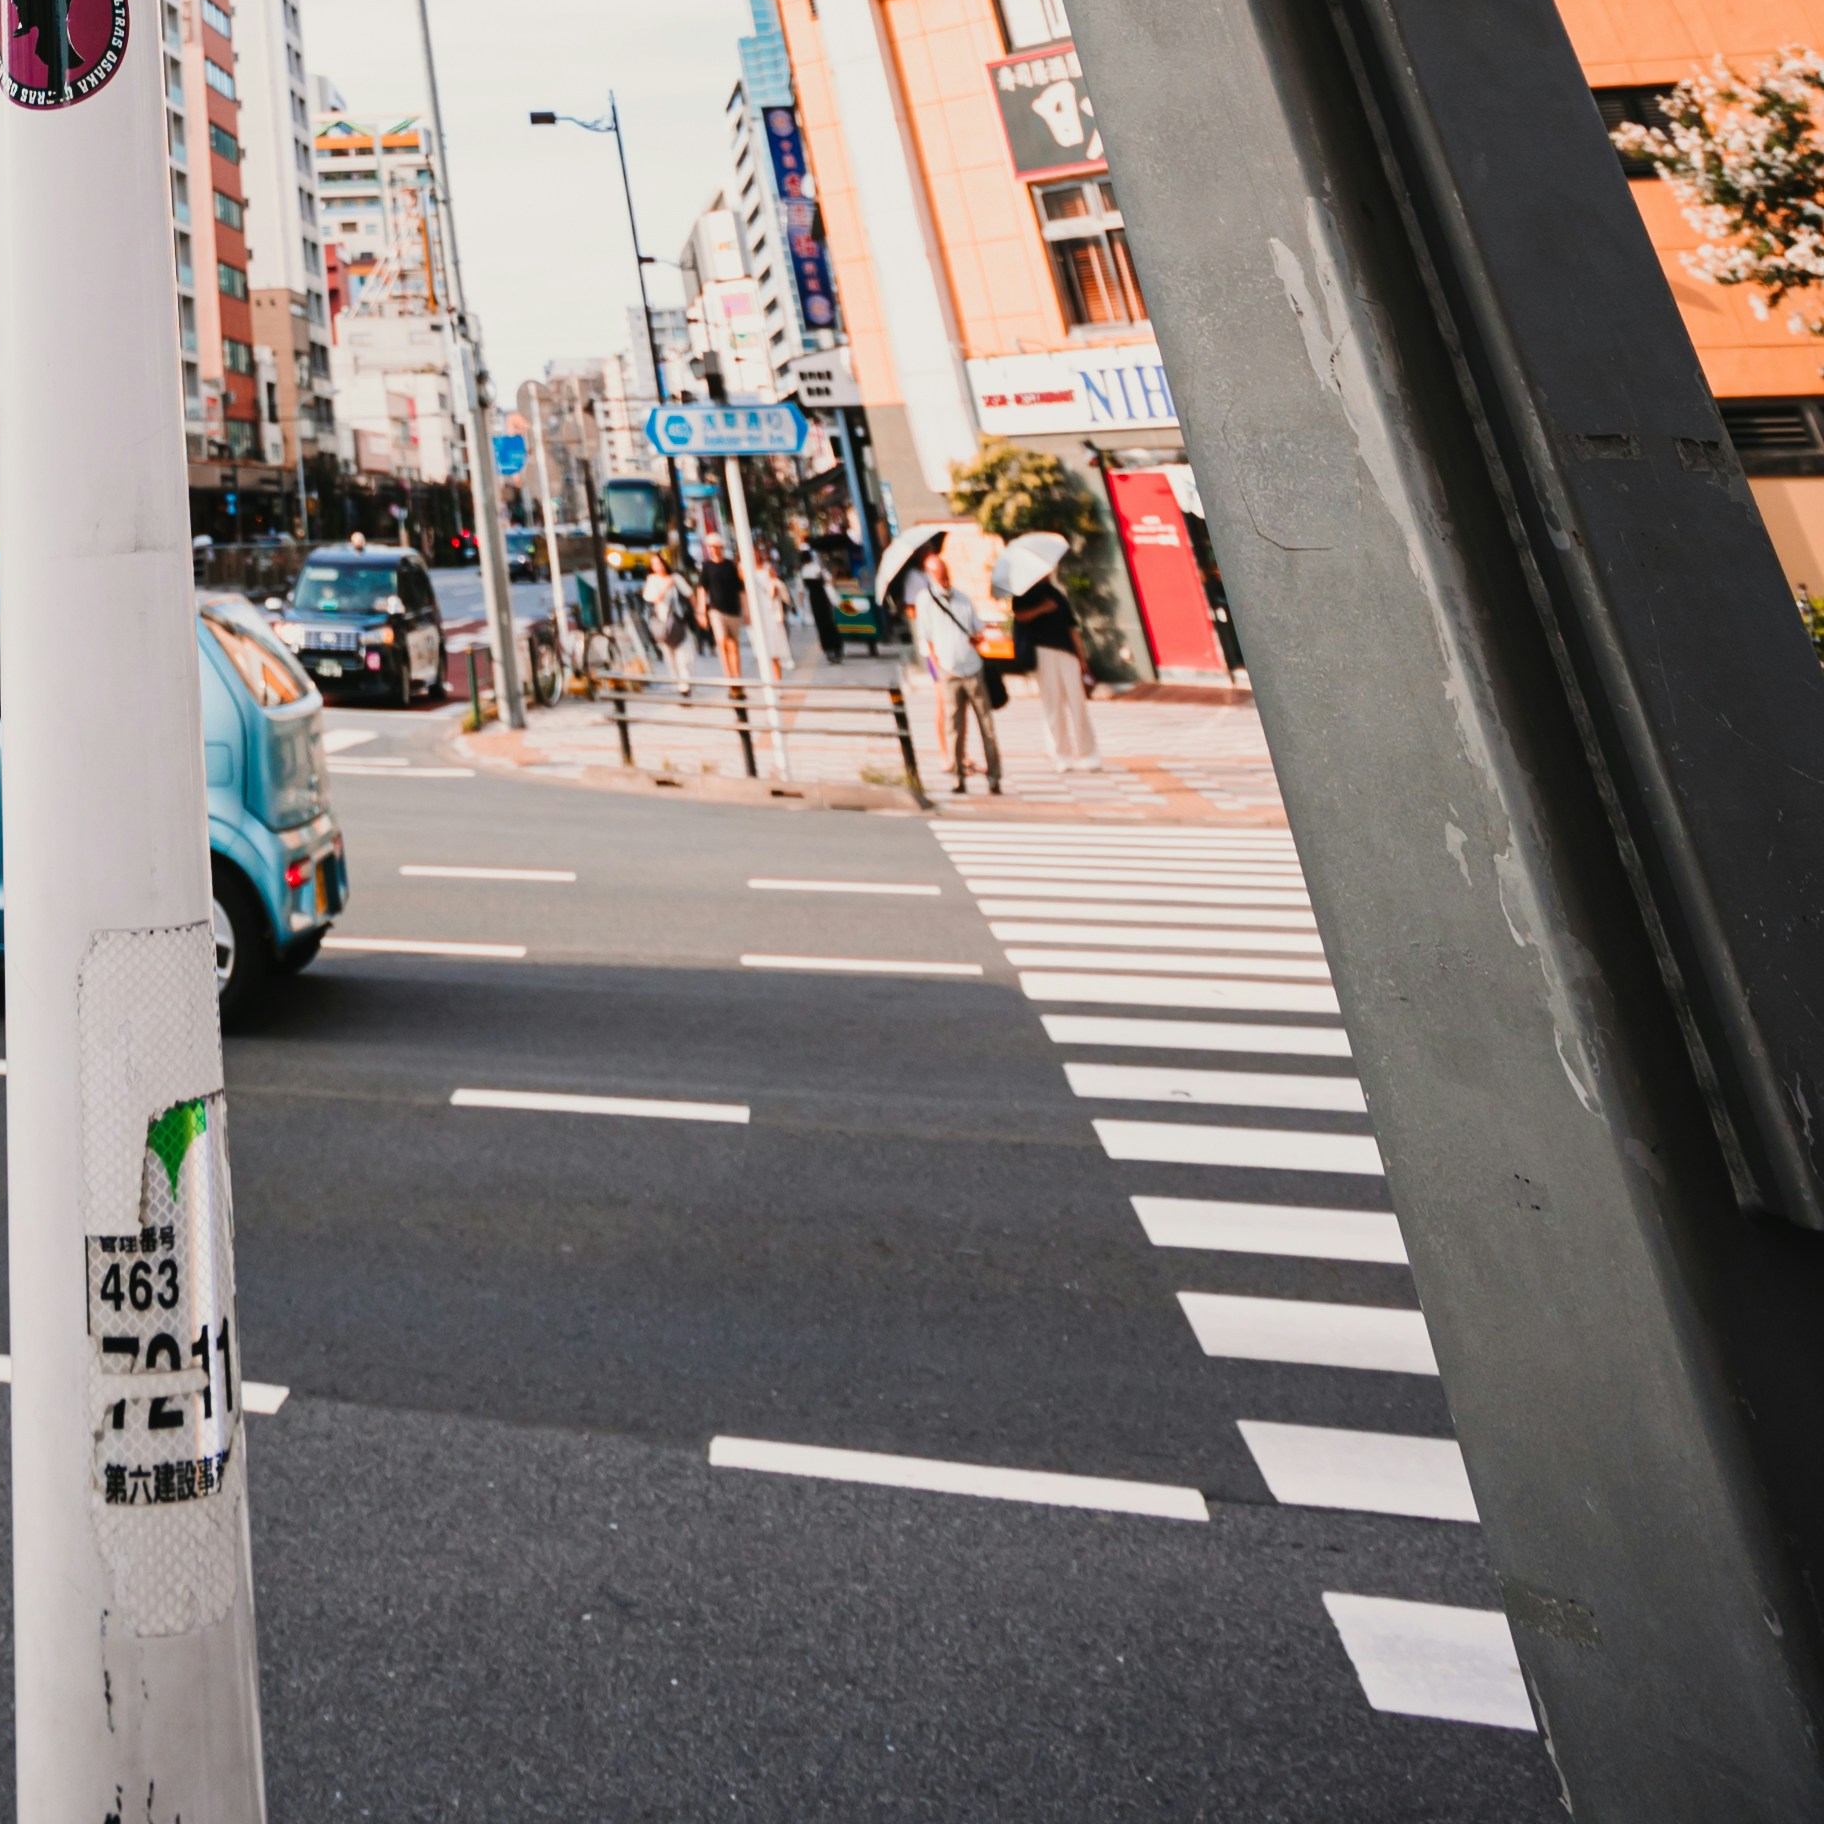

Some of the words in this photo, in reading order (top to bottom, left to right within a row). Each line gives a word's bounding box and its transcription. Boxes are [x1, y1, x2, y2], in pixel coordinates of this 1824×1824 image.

[20, 82, 74, 106] URAS
[78, 50, 118, 94] OSAKA
[100, 1258, 180, 1312] 463
[102, 1317, 233, 1430] 7211
